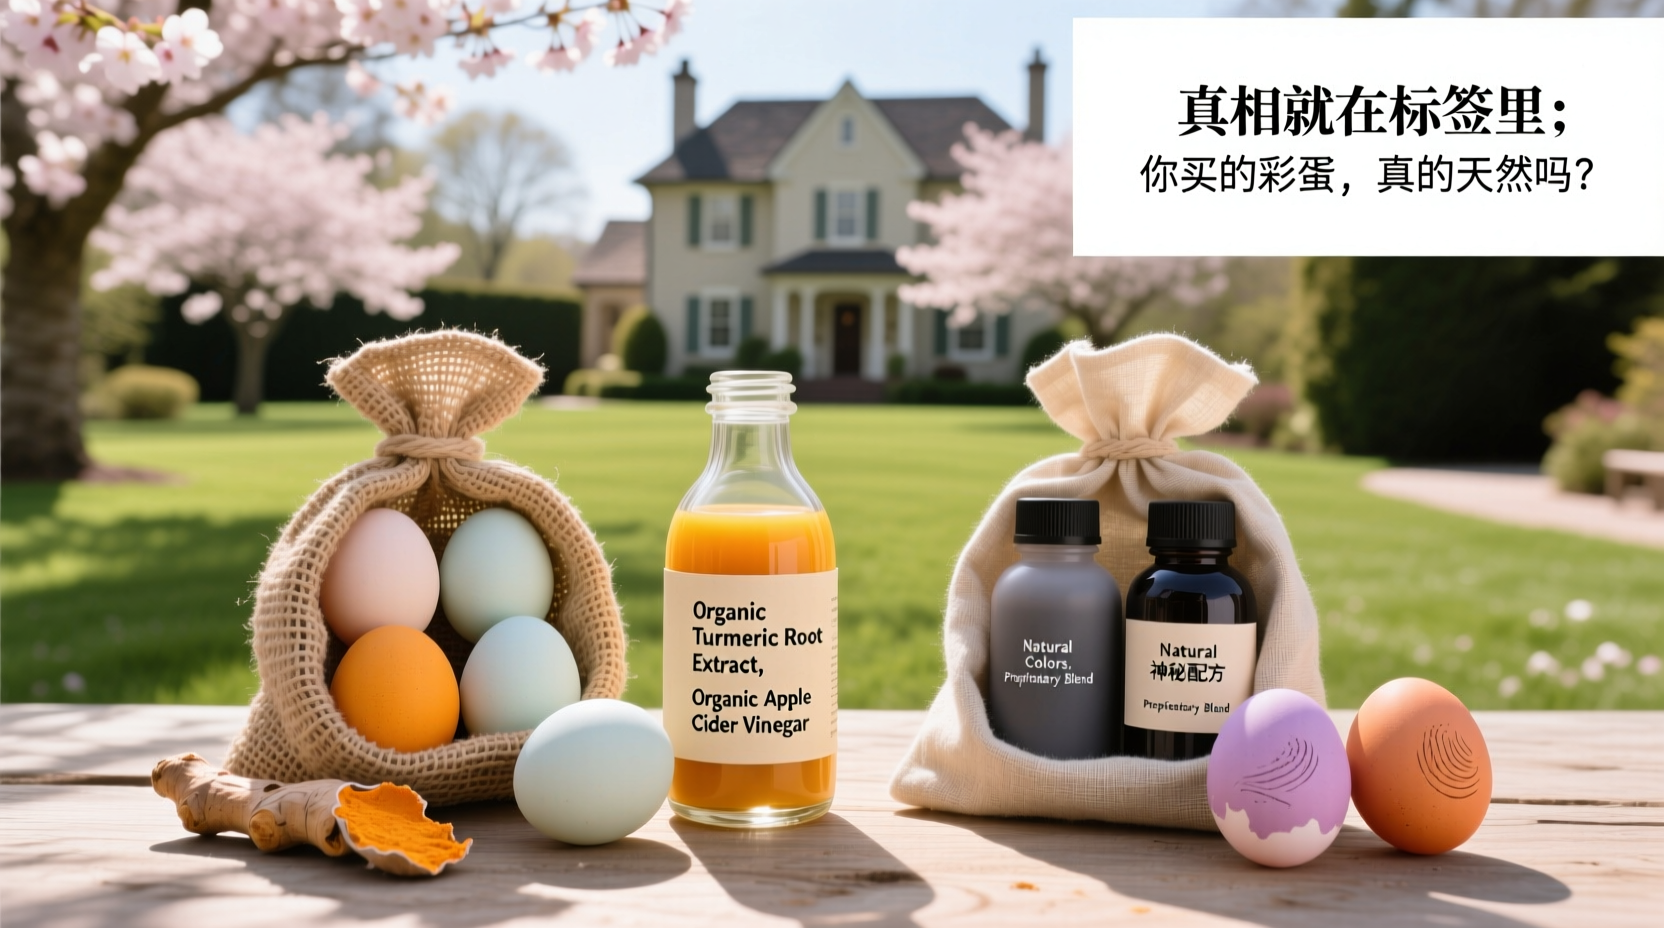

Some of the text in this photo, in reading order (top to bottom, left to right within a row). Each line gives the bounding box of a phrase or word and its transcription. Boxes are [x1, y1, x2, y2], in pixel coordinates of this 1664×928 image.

[693, 601, 766, 626] Organic
[692, 627, 823, 647] Turmeric Root
[1023, 639, 1073, 653] Natural
[1160, 643, 1217, 658] Natural
[693, 653, 764, 677] Extract,
[1150, 660, 1226, 682] 神秘配方
[692, 687, 811, 712] Organic Apple
[692, 714, 809, 738] Cider Vinegar
